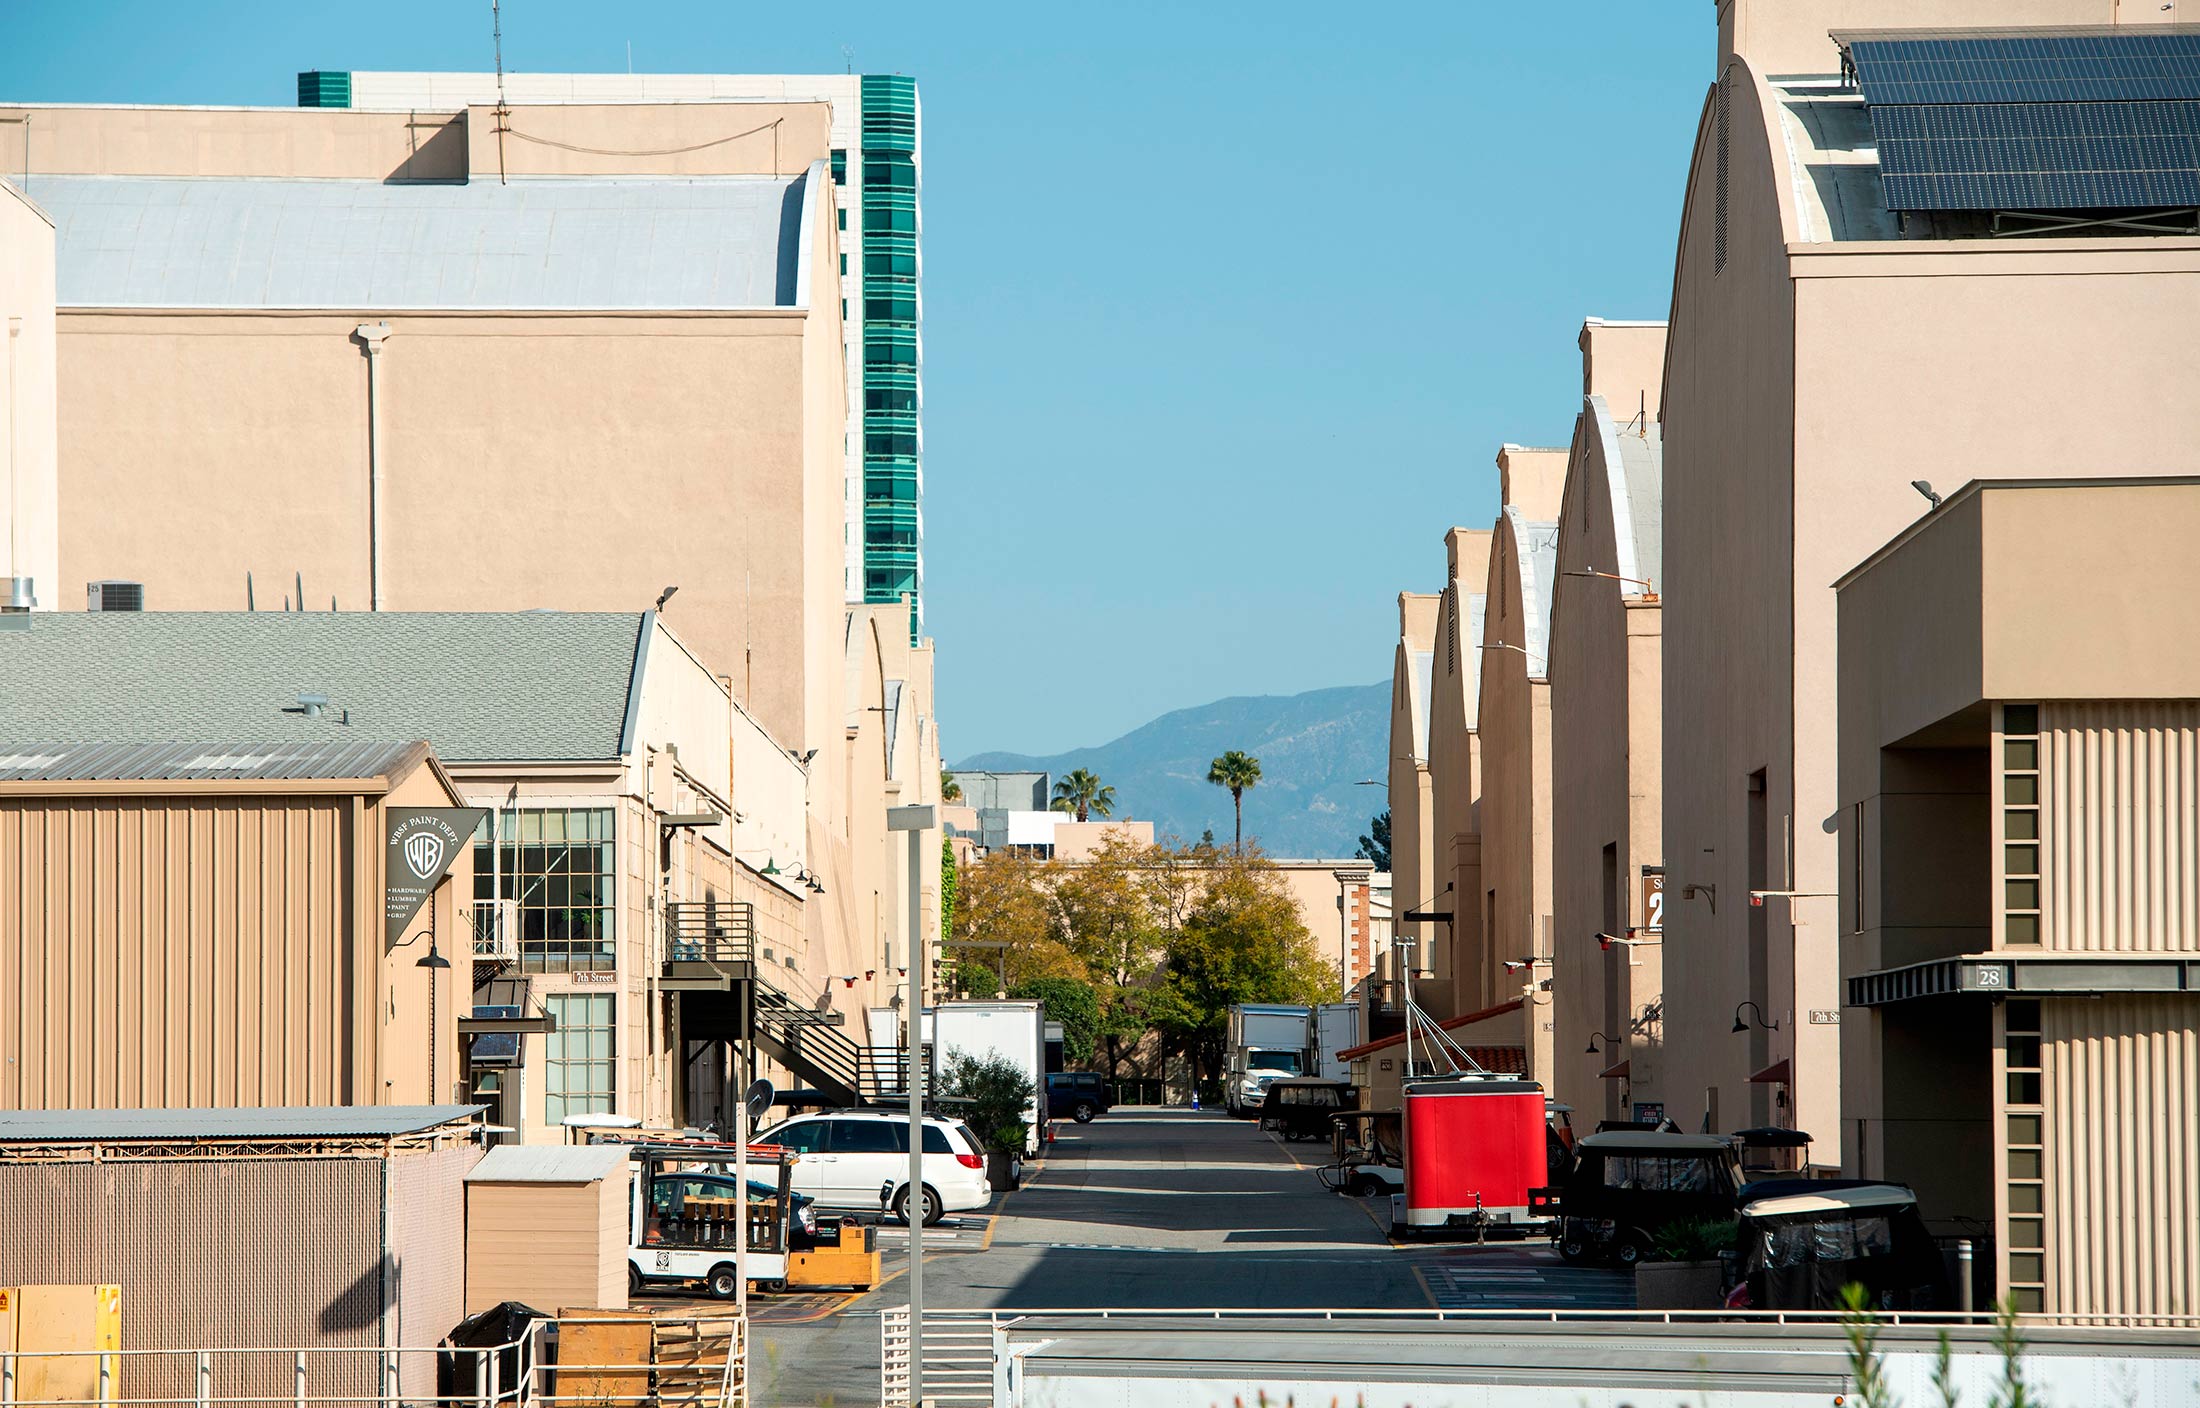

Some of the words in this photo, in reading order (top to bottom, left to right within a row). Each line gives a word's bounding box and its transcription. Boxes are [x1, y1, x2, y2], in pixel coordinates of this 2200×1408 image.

[390, 822, 408, 845] WBSF
[409, 815, 439, 827] PAINT
[439, 821, 459, 846] DEPT.
[409, 837, 438, 874] WB
[576, 973, 589, 982] 7th
[591, 972, 614, 982] Street
[1979, 971, 2000, 985] 28
[1815, 1011, 1828, 1022] 7th
